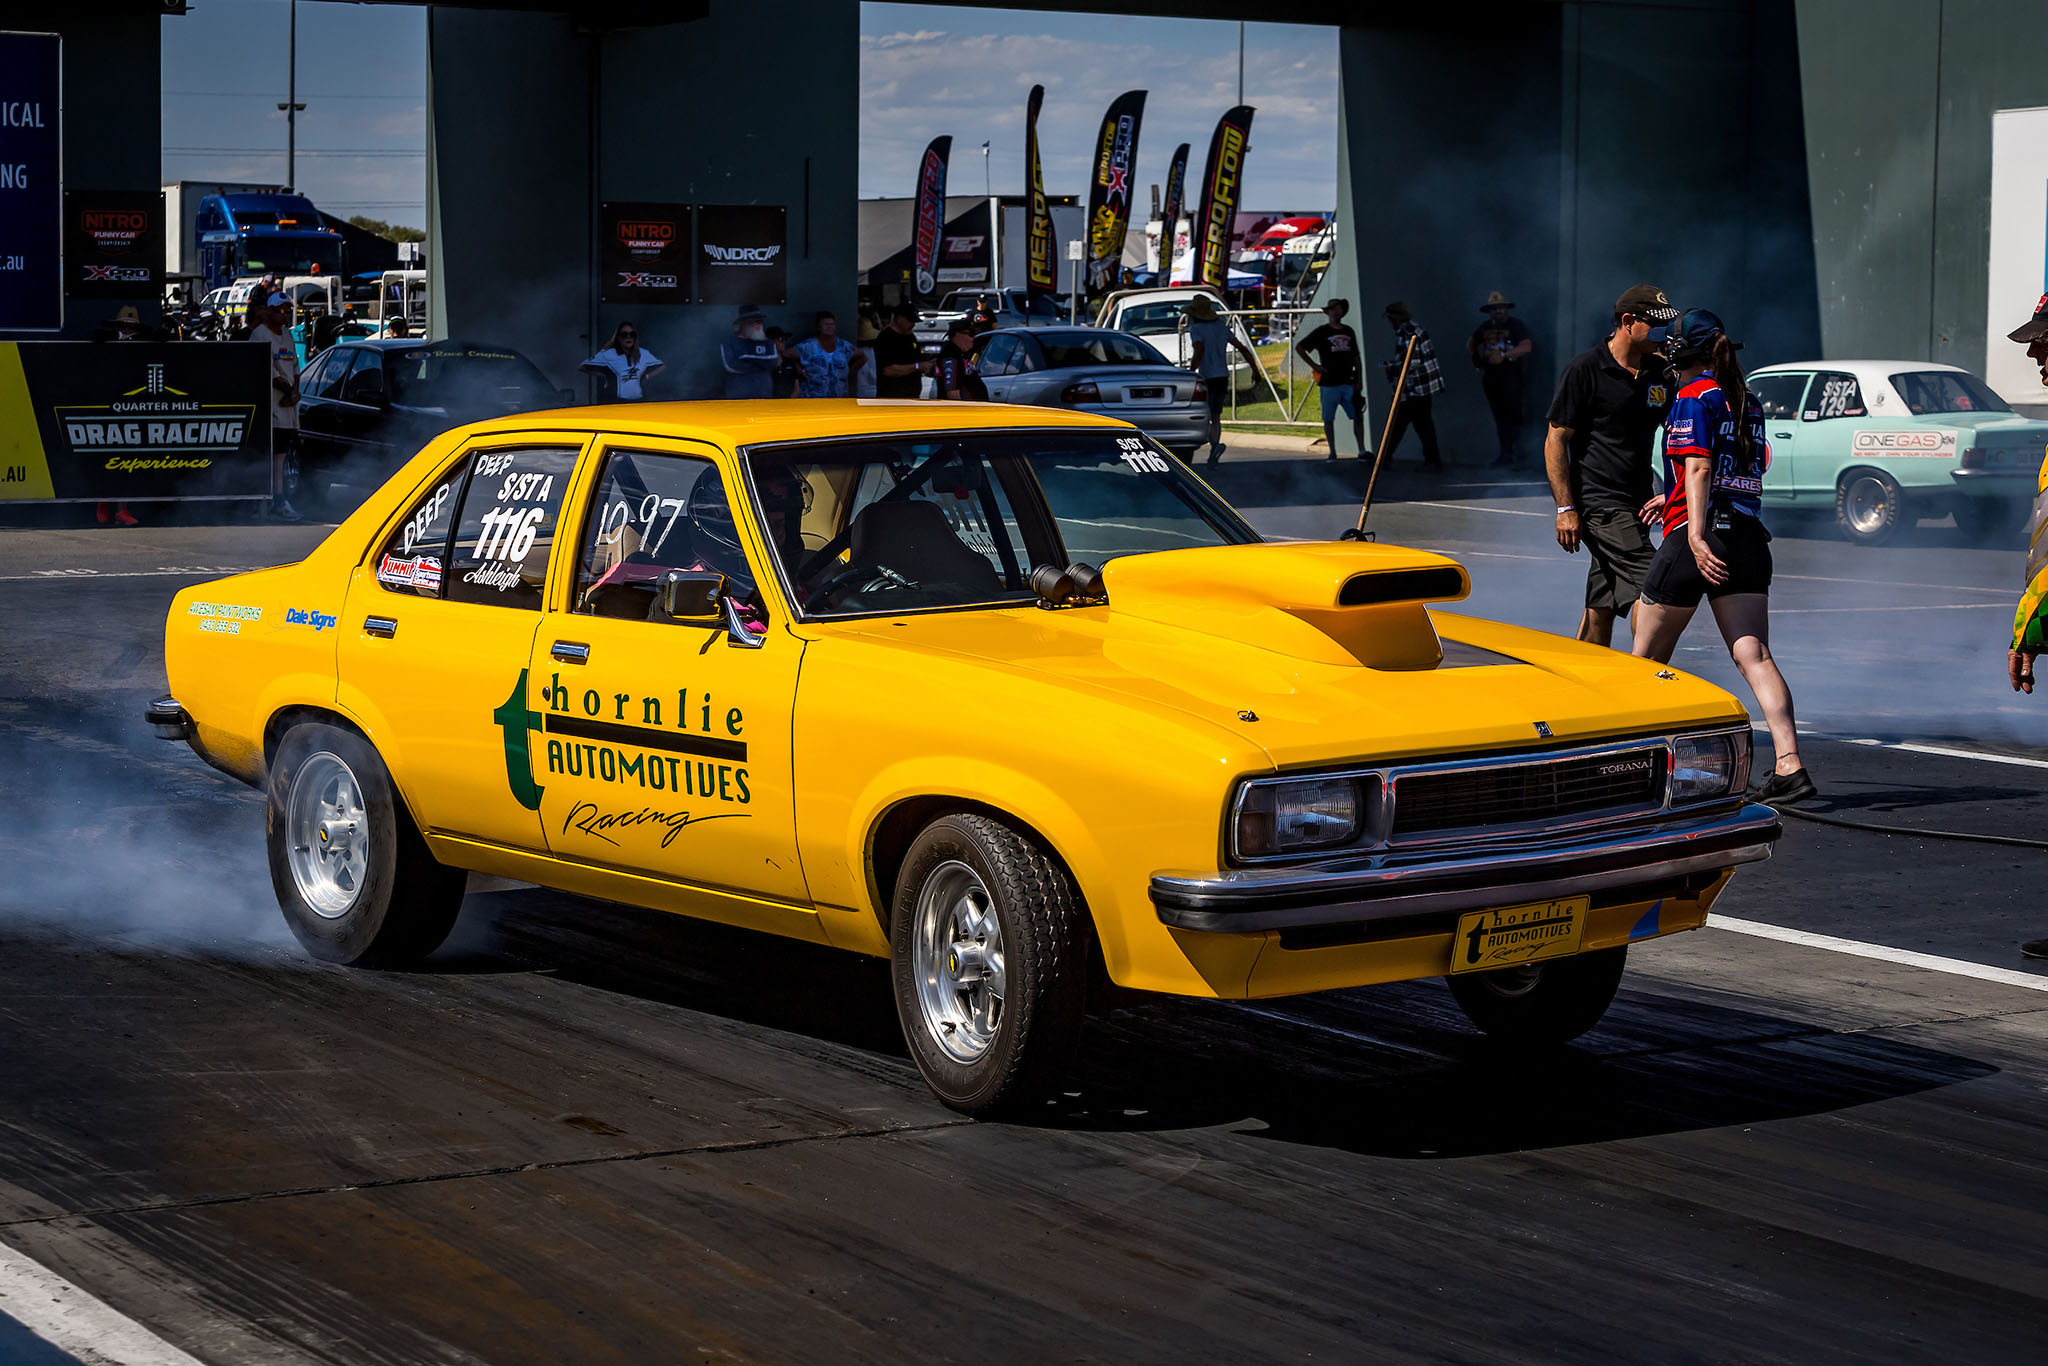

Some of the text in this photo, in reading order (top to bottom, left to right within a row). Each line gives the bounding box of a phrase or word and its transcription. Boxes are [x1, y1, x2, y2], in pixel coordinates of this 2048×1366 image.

[915, 149, 941, 269] BOOSTED
[1202, 125, 1244, 287] AEROFLOW
[85, 213, 145, 229] NITRO
[620, 223, 673, 239] NITRO
[94, 231, 136, 239] FUNNY CAR
[628, 240, 651, 248] FUNNY
[714, 246, 770, 261] NDRC
[112, 401, 200, 413] QUARTER MILE
[1819, 396, 1847, 417] 129
[66, 421, 244, 446] DRAG RACING
[1115, 438, 1145, 451] S/ST
[105, 455, 213, 473] Experience
[474, 454, 515, 478] DEEP
[1120, 450, 1170, 474] 1116
[404, 482, 450, 555] DEEP
[471, 506, 545, 563] 1116
[381, 553, 415, 577] SUMMIT
[462, 561, 524, 592] Ashleigh
[285, 608, 337, 631] Dale Signs
[548, 740, 750, 804] AUTOMOTIVES
[1600, 761, 1649, 775] TORANA
[562, 800, 752, 849] Racing
[1487, 923, 1572, 948] AUTOMOTIVES
[1484, 938, 1569, 962] Racing
